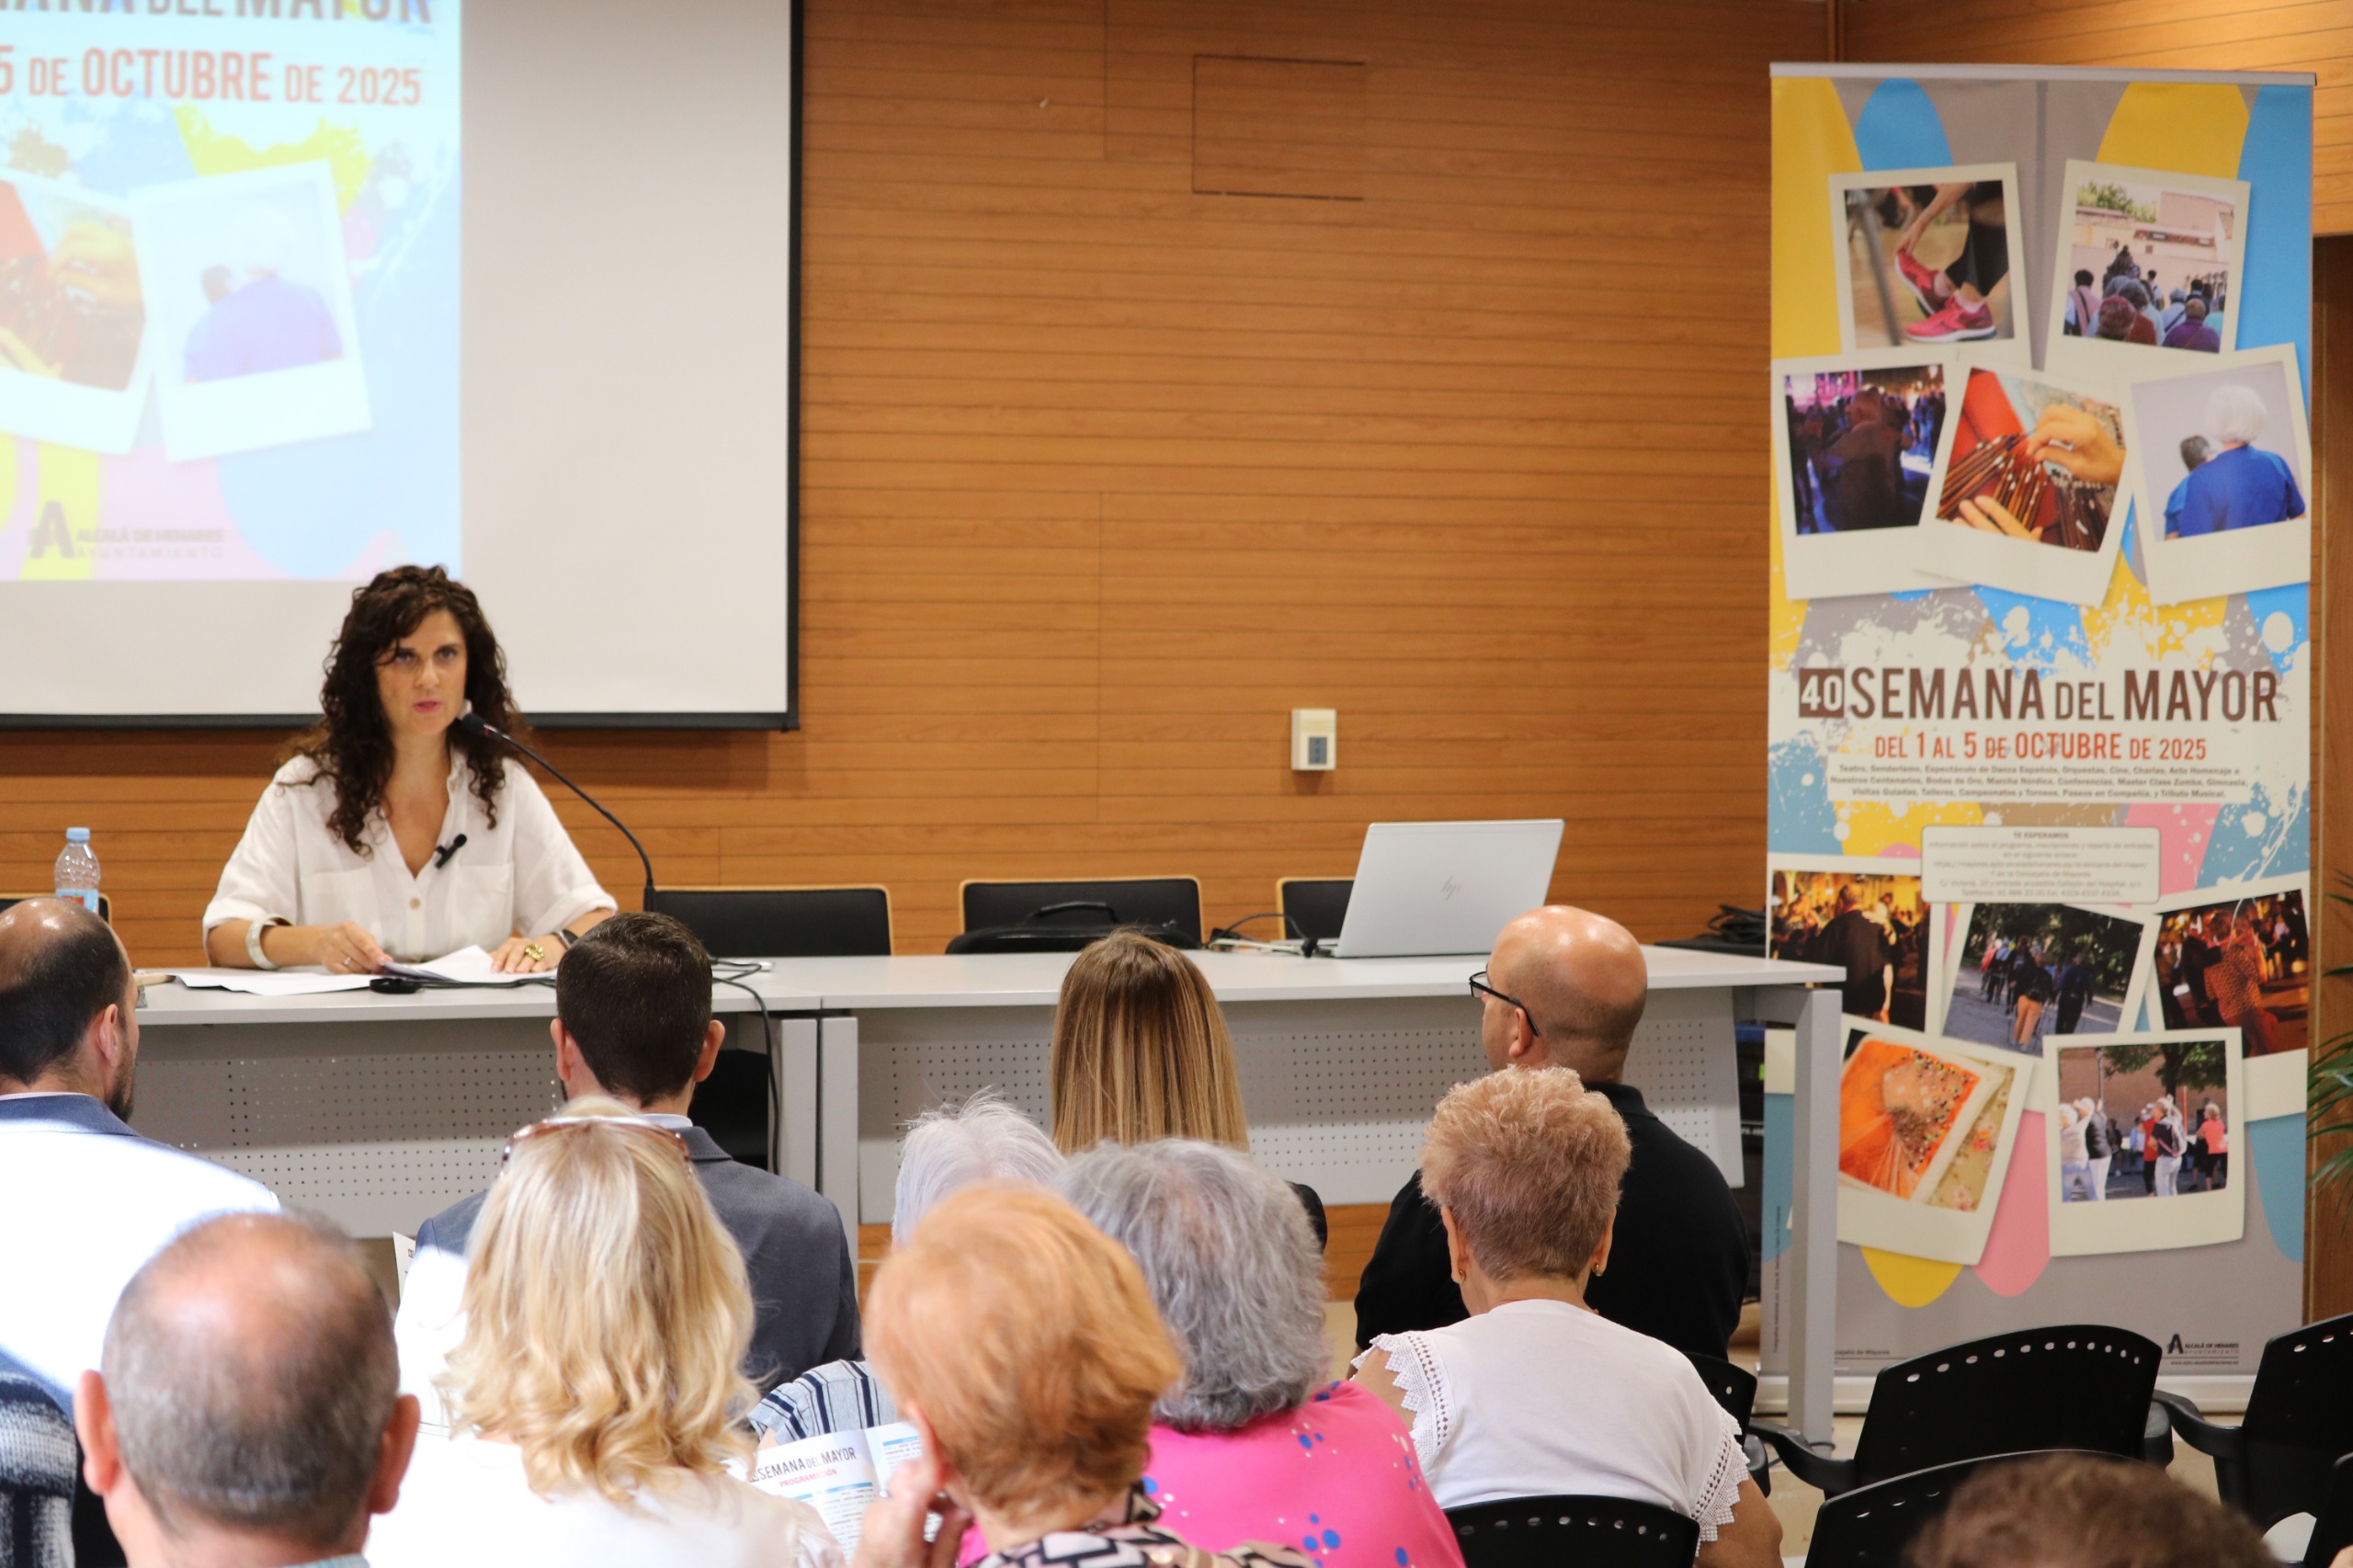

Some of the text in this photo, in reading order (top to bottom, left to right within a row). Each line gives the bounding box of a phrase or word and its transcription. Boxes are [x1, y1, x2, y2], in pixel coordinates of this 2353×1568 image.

[28, 57, 68, 96] DE
[82, 47, 272, 101] OCTUBRE
[284, 65, 324, 103] DE
[336, 66, 421, 105] 2025
[1850, 667, 2045, 720] SEMANA
[2054, 682, 2114, 721] DEL
[2123, 669, 2279, 722] MAYOR
[1875, 732, 2207, 761] DEL 1 AL 5 DE OCTUBRE DE 2025
[1830, 777, 1868, 785] Nuestros
[1870, 777, 1922, 786] Centenarios,
[1926, 777, 1952, 785] Bodas
[1955, 777, 1965, 785] de
[1986, 777, 2018, 785] Marcha
[2020, 777, 2055, 786] Nórdica,
[2058, 777, 2115, 787] Conferencias,
[2118, 778, 2146, 786] Master
[2149, 778, 2172, 786] Class
[2174, 778, 2205, 787] Zumba,
[2207, 778, 2249, 788] Gimnasia,
[1839, 765, 1869, 774] Teatro,
[1870, 765, 1921, 774] Senderismo,
[1925, 765, 1977, 775] Espectáculo
[1979, 766, 1989, 774] de
[1991, 766, 2017, 774] Danza
[2019, 766, 2060, 776] Española,
[2063, 766, 2108, 776] Orquestas,
[2109, 767, 2130, 775] Cine,
[2133, 767, 2165, 776] Charlas,
[2169, 767, 2188, 775] Acto
[2190, 767, 2233, 777] Homenaje
[1852, 788, 1881, 796] Visitas
[1883, 788, 1919, 797] Guiadas,
[1922, 788, 1955, 797] Talleres,
[1959, 789, 2016, 798] Campeonatos
[2025, 789, 2060, 798] Torneos,
[2063, 789, 2093, 798] Paseos
[2161, 790, 2189, 798] Tributo
[756, 1458, 806, 1482] SEMANA
[805, 1457, 821, 1470] DEL
[821, 1447, 857, 1465] MAYOR
